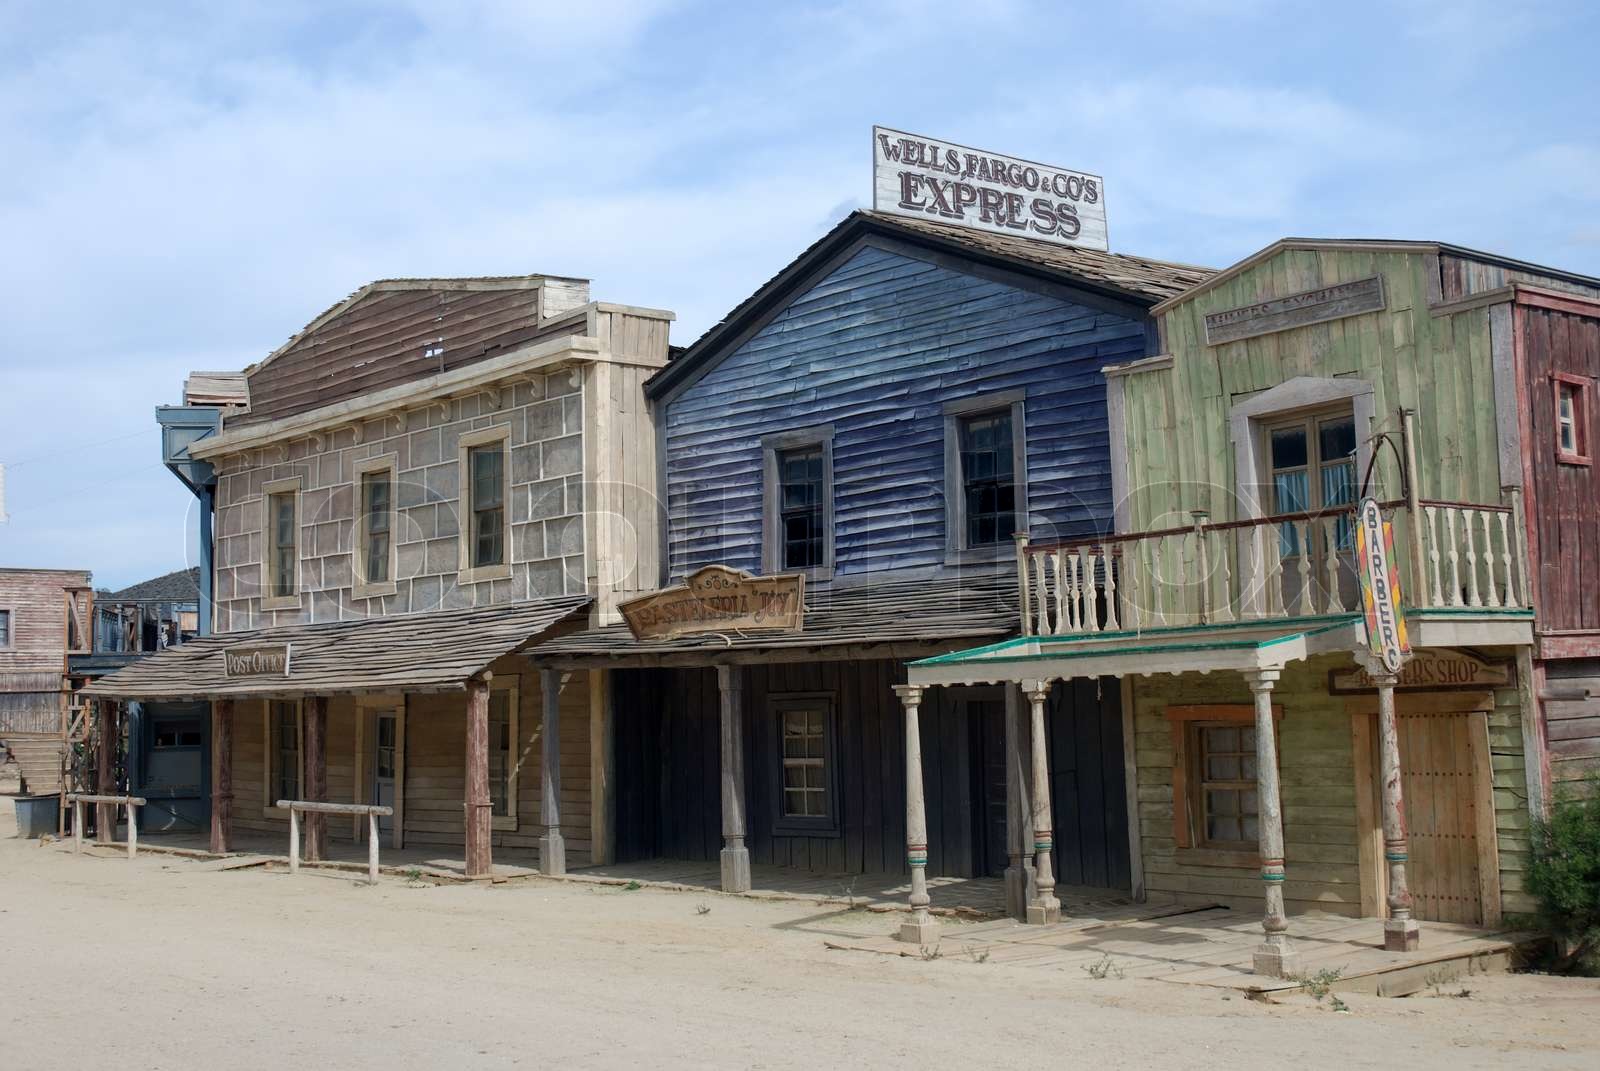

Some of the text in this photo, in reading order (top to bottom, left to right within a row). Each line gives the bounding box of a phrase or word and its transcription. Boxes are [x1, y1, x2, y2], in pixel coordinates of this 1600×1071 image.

[963, 153, 1040, 192] FARGO
[1040, 176, 1052, 193] &
[1051, 172, 1099, 204] CO'S
[898, 170, 1082, 241] EXPRESS
[227, 653, 252, 674] POST
[1436, 659, 1479, 684] SHOP
